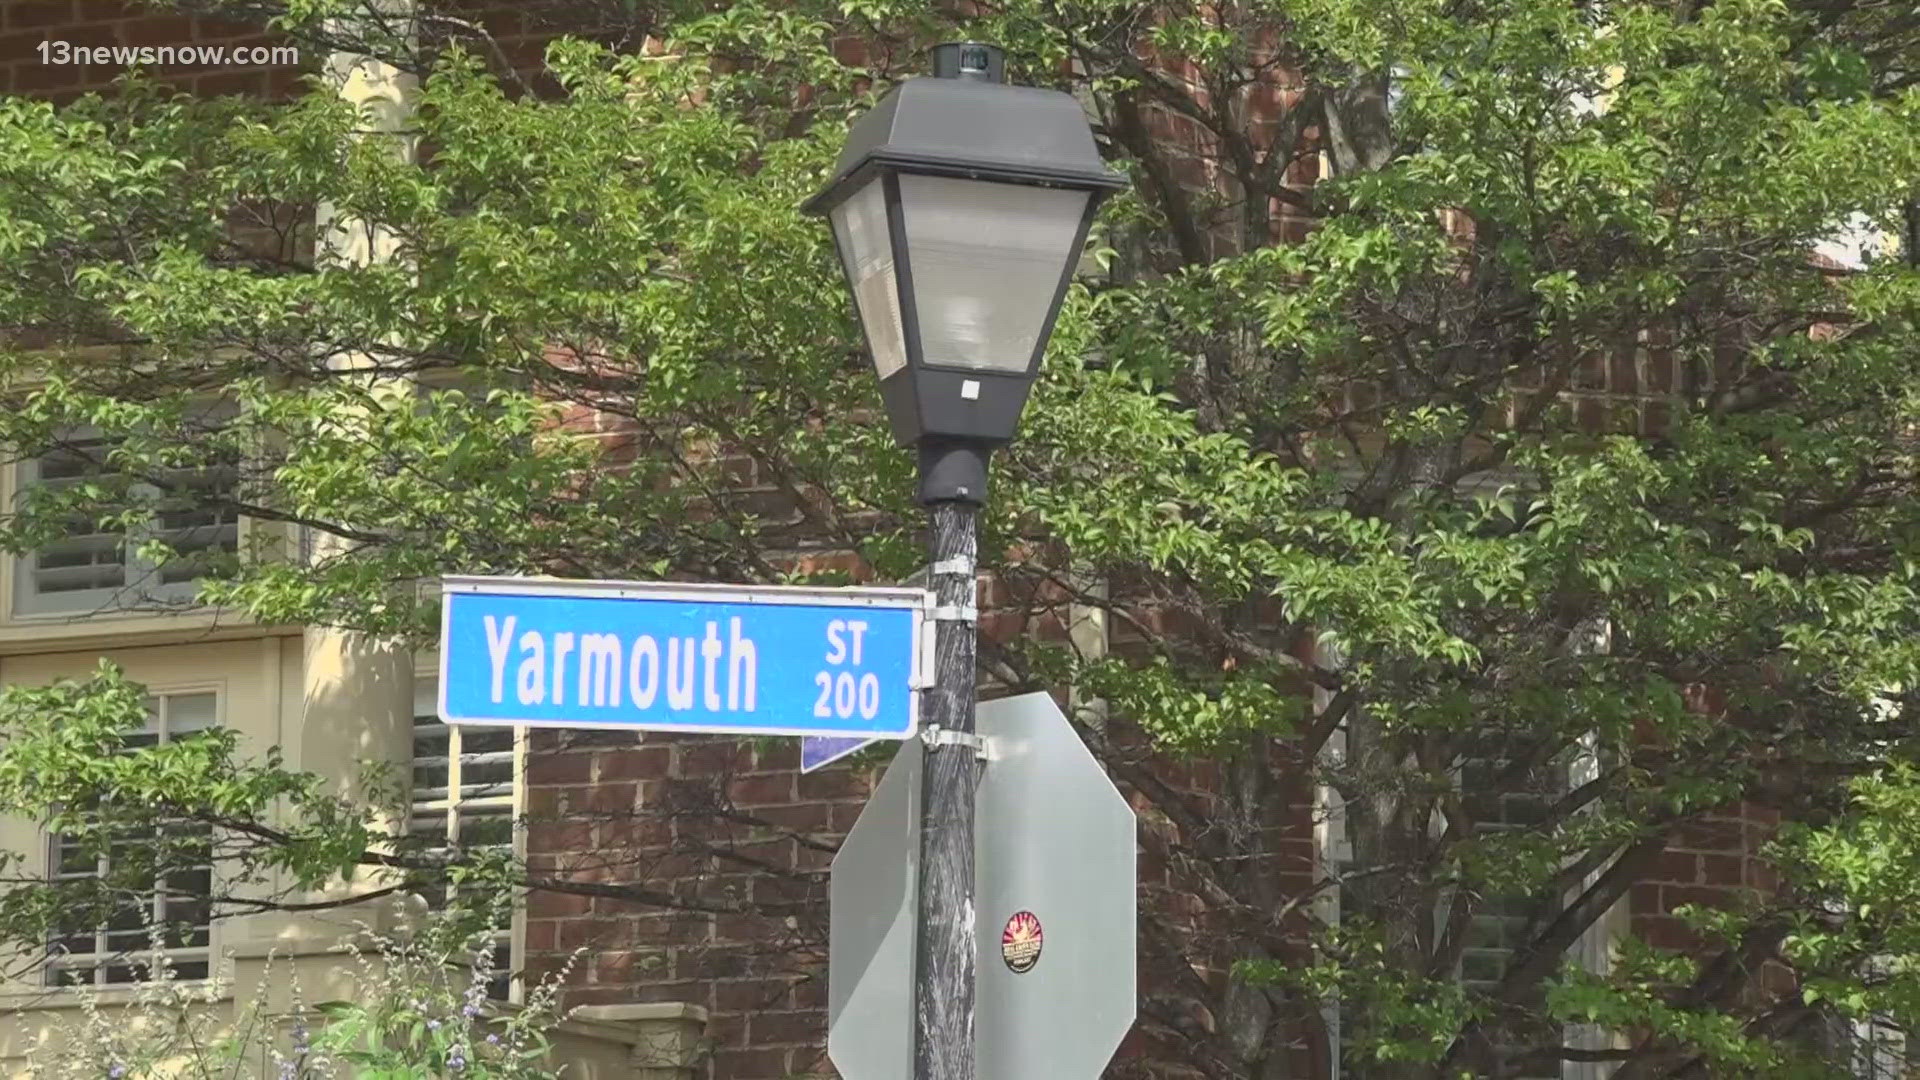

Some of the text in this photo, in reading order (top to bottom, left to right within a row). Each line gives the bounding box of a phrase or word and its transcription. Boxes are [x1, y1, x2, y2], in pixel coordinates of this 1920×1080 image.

[484, 615, 867, 712] Yarmouth ST
[813, 672, 879, 720] 200
